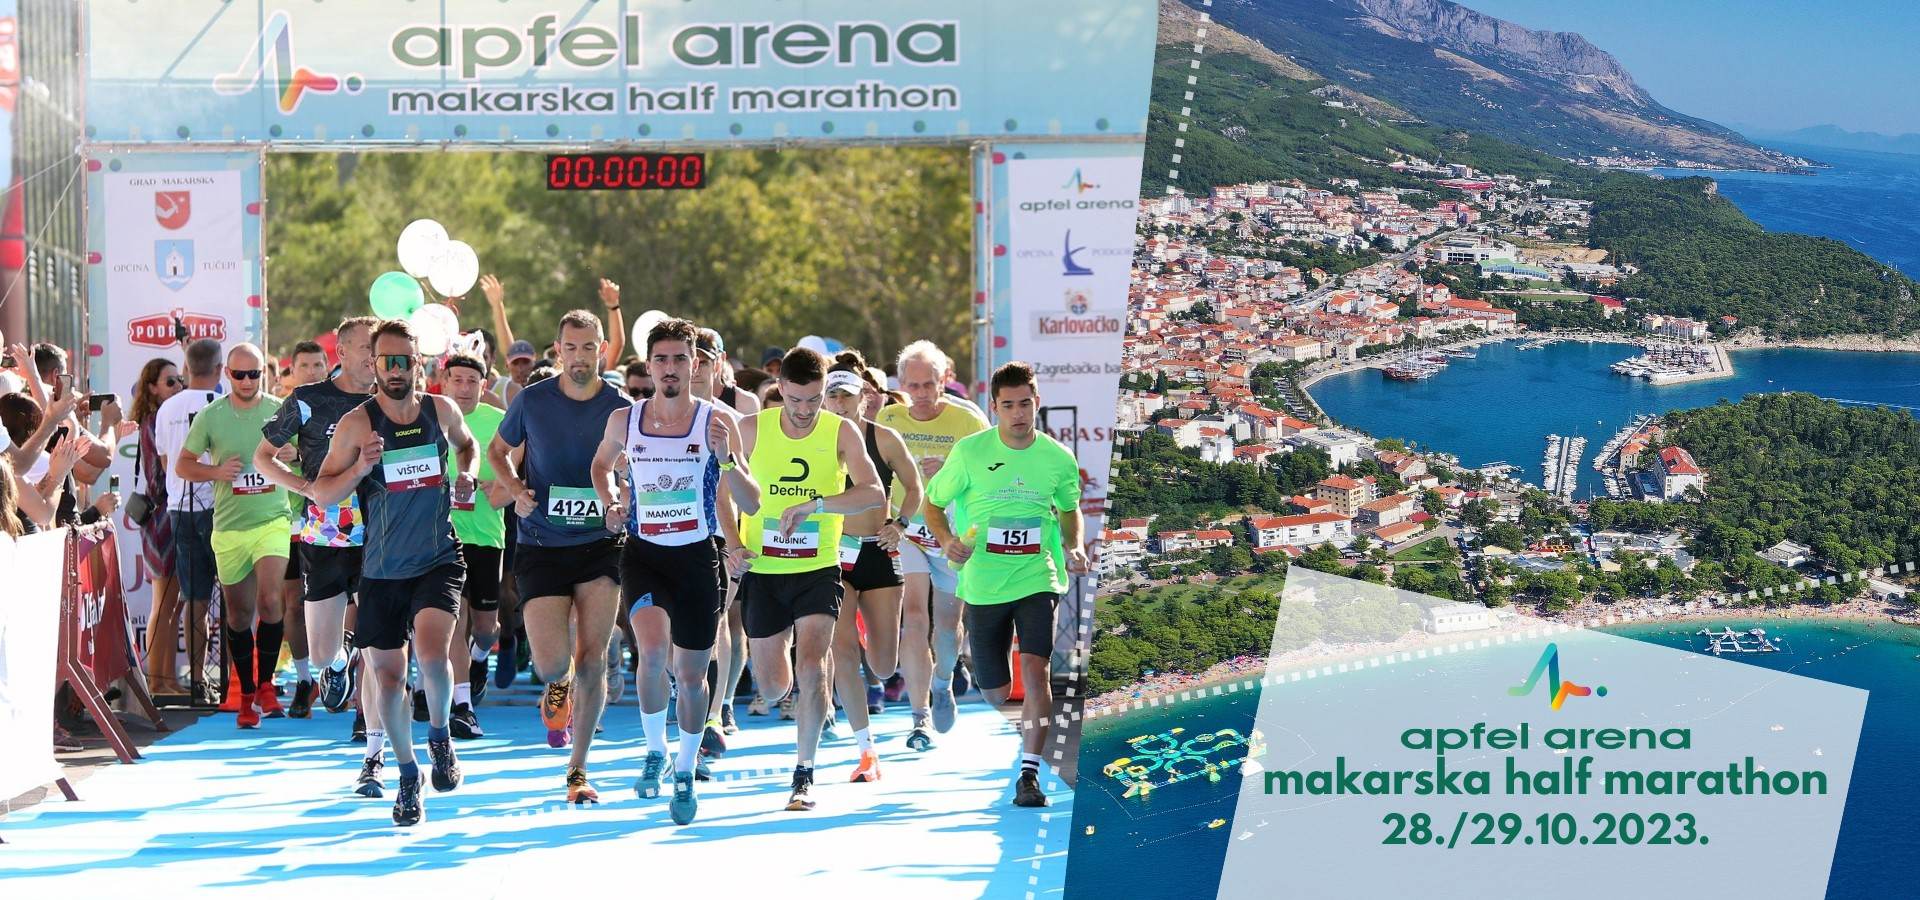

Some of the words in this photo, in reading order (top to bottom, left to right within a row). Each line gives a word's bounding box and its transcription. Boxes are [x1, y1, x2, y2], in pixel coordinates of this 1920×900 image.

[391, 15, 640, 78] apfel
[672, 22, 957, 65] arena
[391, 86, 615, 112] makarska
[629, 85, 716, 111] half
[733, 83, 957, 110] marathon
[129, 178, 156, 187] GRAD
[161, 176, 215, 186] MAKARSKA
[1020, 200, 1071, 213] apfel
[1076, 199, 1135, 210] arena
[1092, 247, 1133, 257] PODGOR
[136, 323, 219, 339] PODRVKA
[1039, 314, 1120, 335] Karlovačko
[1034, 361, 1101, 378] Zagrebačka
[1105, 362, 1120, 374] ba
[902, 433, 934, 441] MOSTAR
[935, 435, 955, 443] 2020
[396, 464, 431, 476] VIŠTICA
[243, 473, 265, 487] 115
[769, 484, 817, 498] Dechra
[552, 499, 600, 516] 412A
[645, 506, 692, 519] IMAMOVIĆ
[773, 535, 808, 545] RUBINIĆ
[1002, 530, 1029, 545] 151
